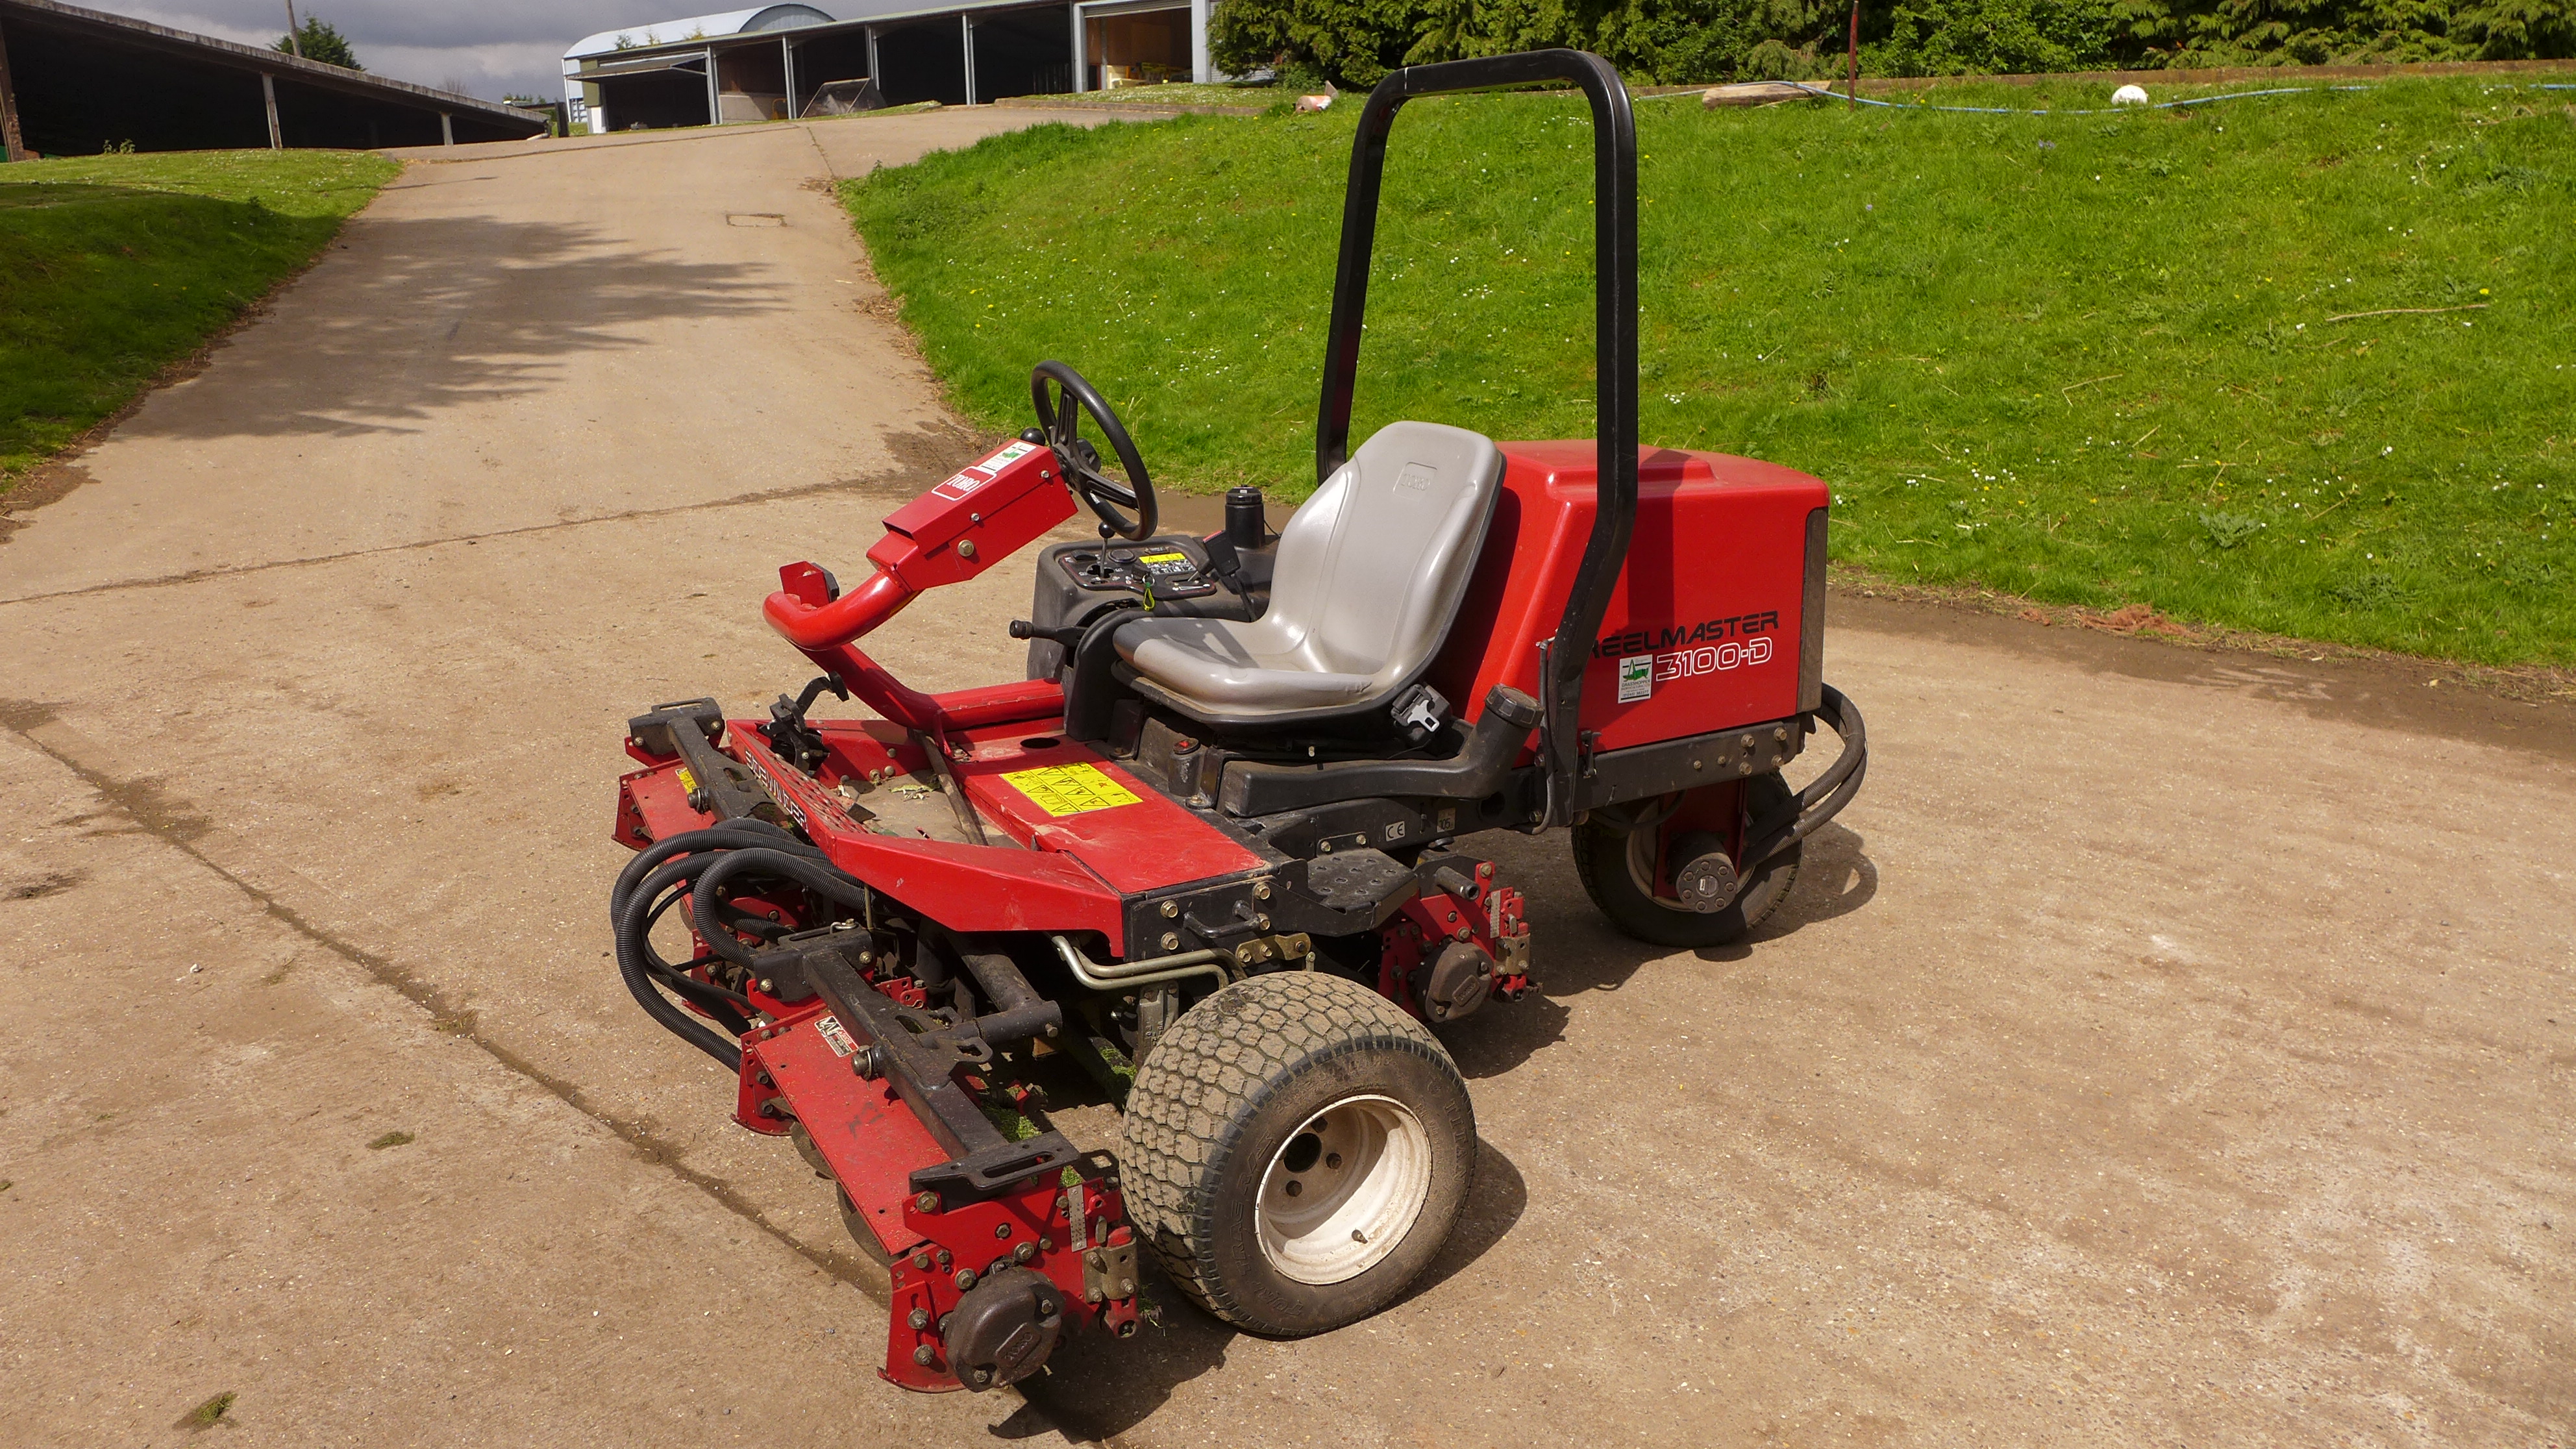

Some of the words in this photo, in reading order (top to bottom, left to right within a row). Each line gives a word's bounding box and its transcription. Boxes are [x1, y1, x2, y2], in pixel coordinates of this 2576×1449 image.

[947, 475, 980, 491] TORO
[1656, 637, 1772, 681] 3100-D
[745, 750, 809, 833] SIDEWINDER
[1387, 823, 1404, 838] CE
[1444, 1098, 1468, 1183] TITAN
